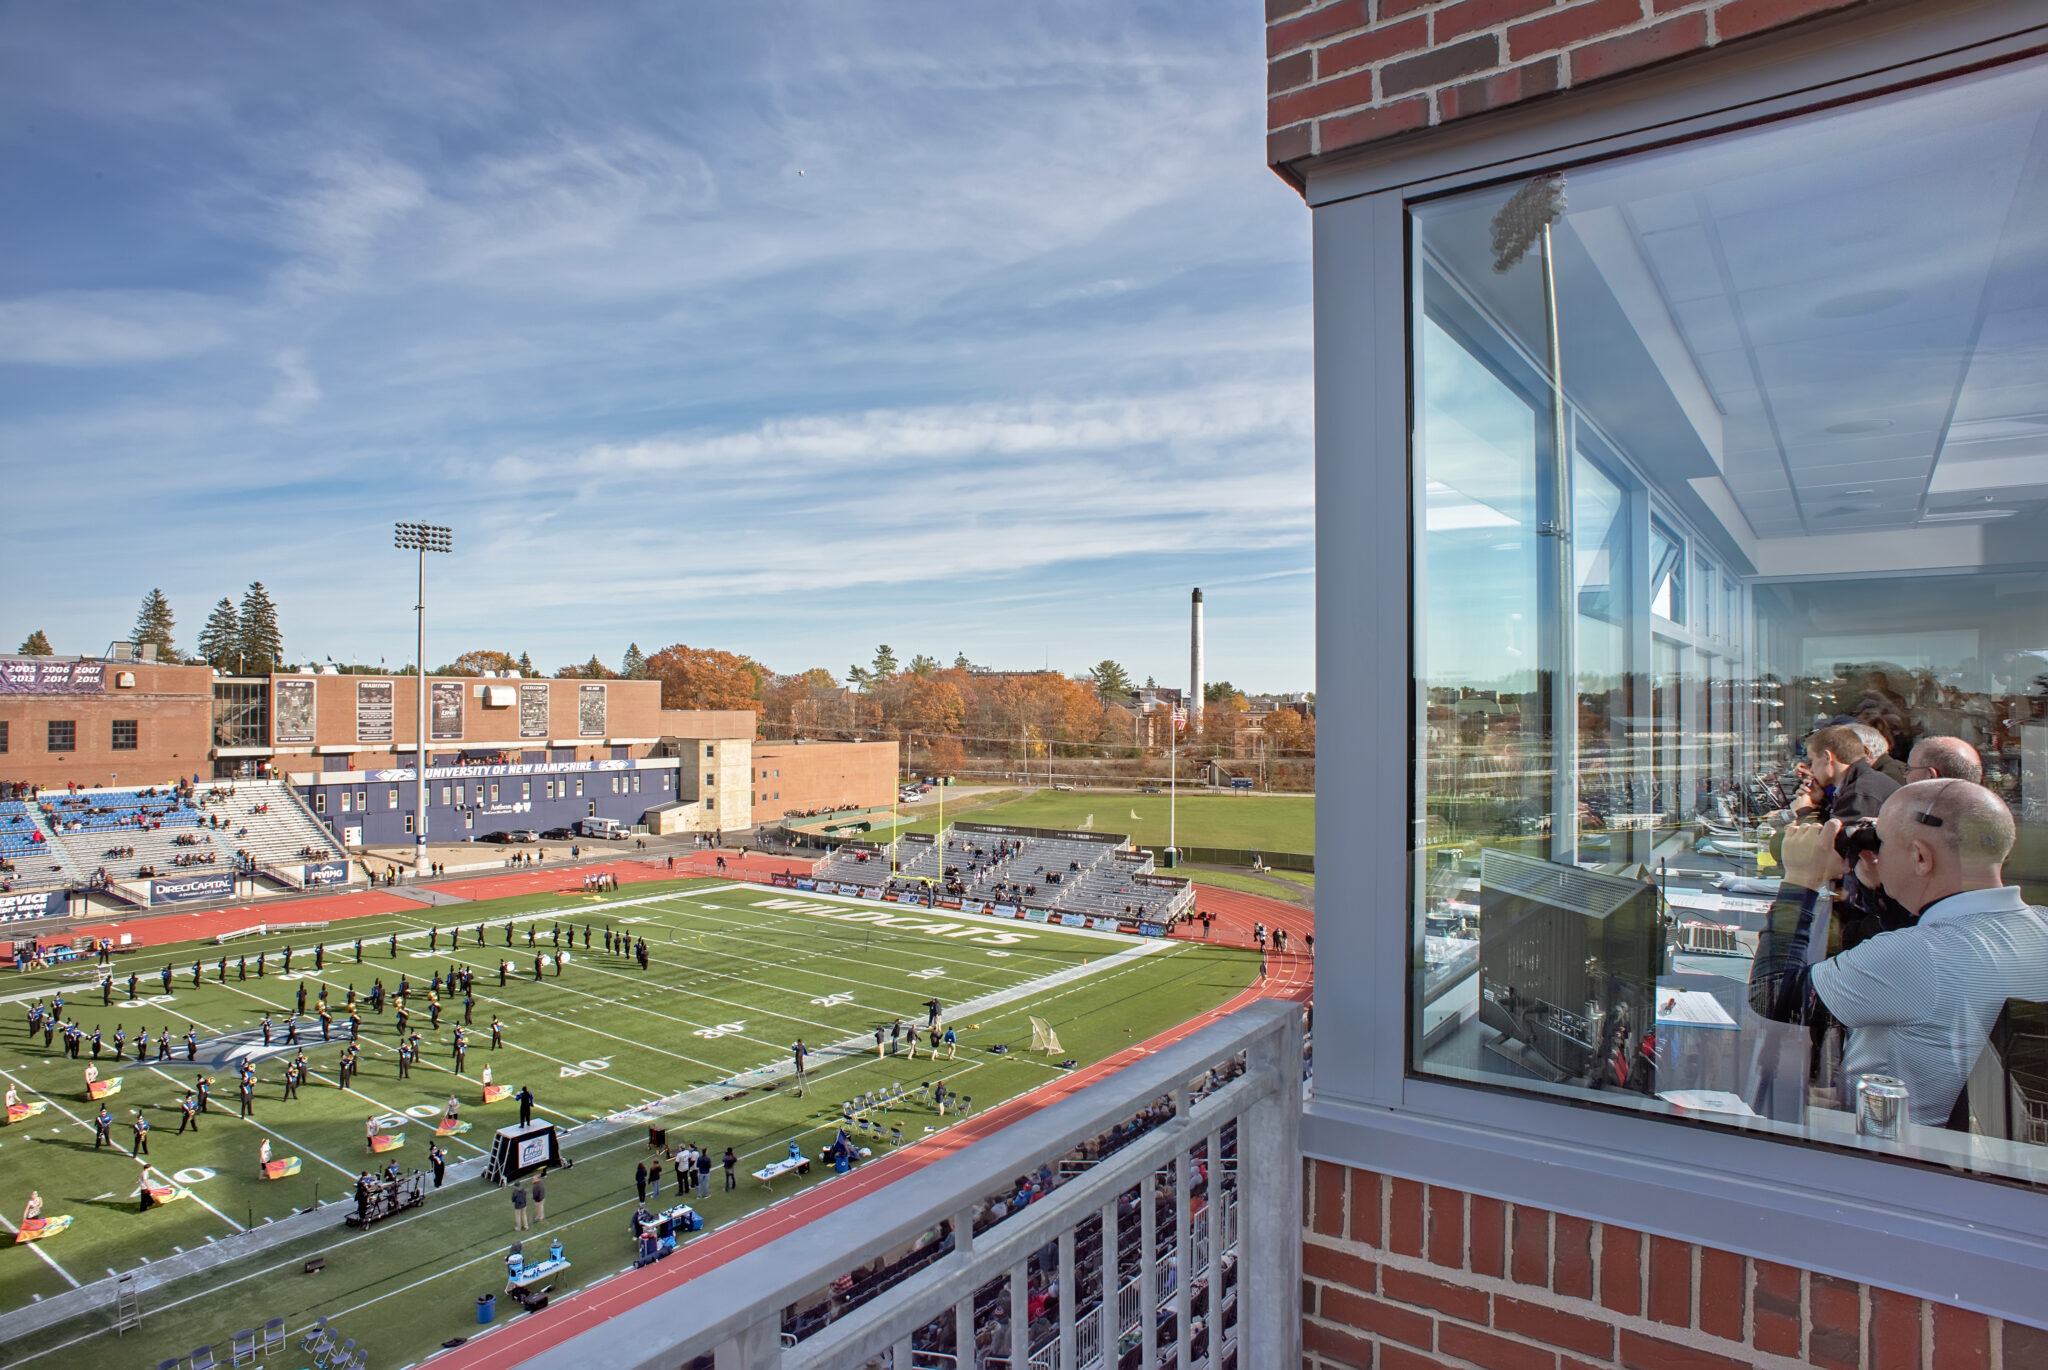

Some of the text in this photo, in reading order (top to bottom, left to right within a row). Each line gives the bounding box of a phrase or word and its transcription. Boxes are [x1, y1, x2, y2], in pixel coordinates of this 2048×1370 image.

[8, 665, 101, 674] 2005 2006 2007
[43, 675, 69, 683] 2014
[424, 761, 592, 779] UNIVERSITY OF NEW HAMPSHIRE
[311, 869, 344, 880] IRVING
[17, 903, 47, 911] UNION
[748, 898, 1041, 945] WILDCATS
[907, 968, 945, 980] 10
[810, 993, 854, 1008] 20
[693, 1024, 744, 1039] 30
[560, 1060, 610, 1078] 40
